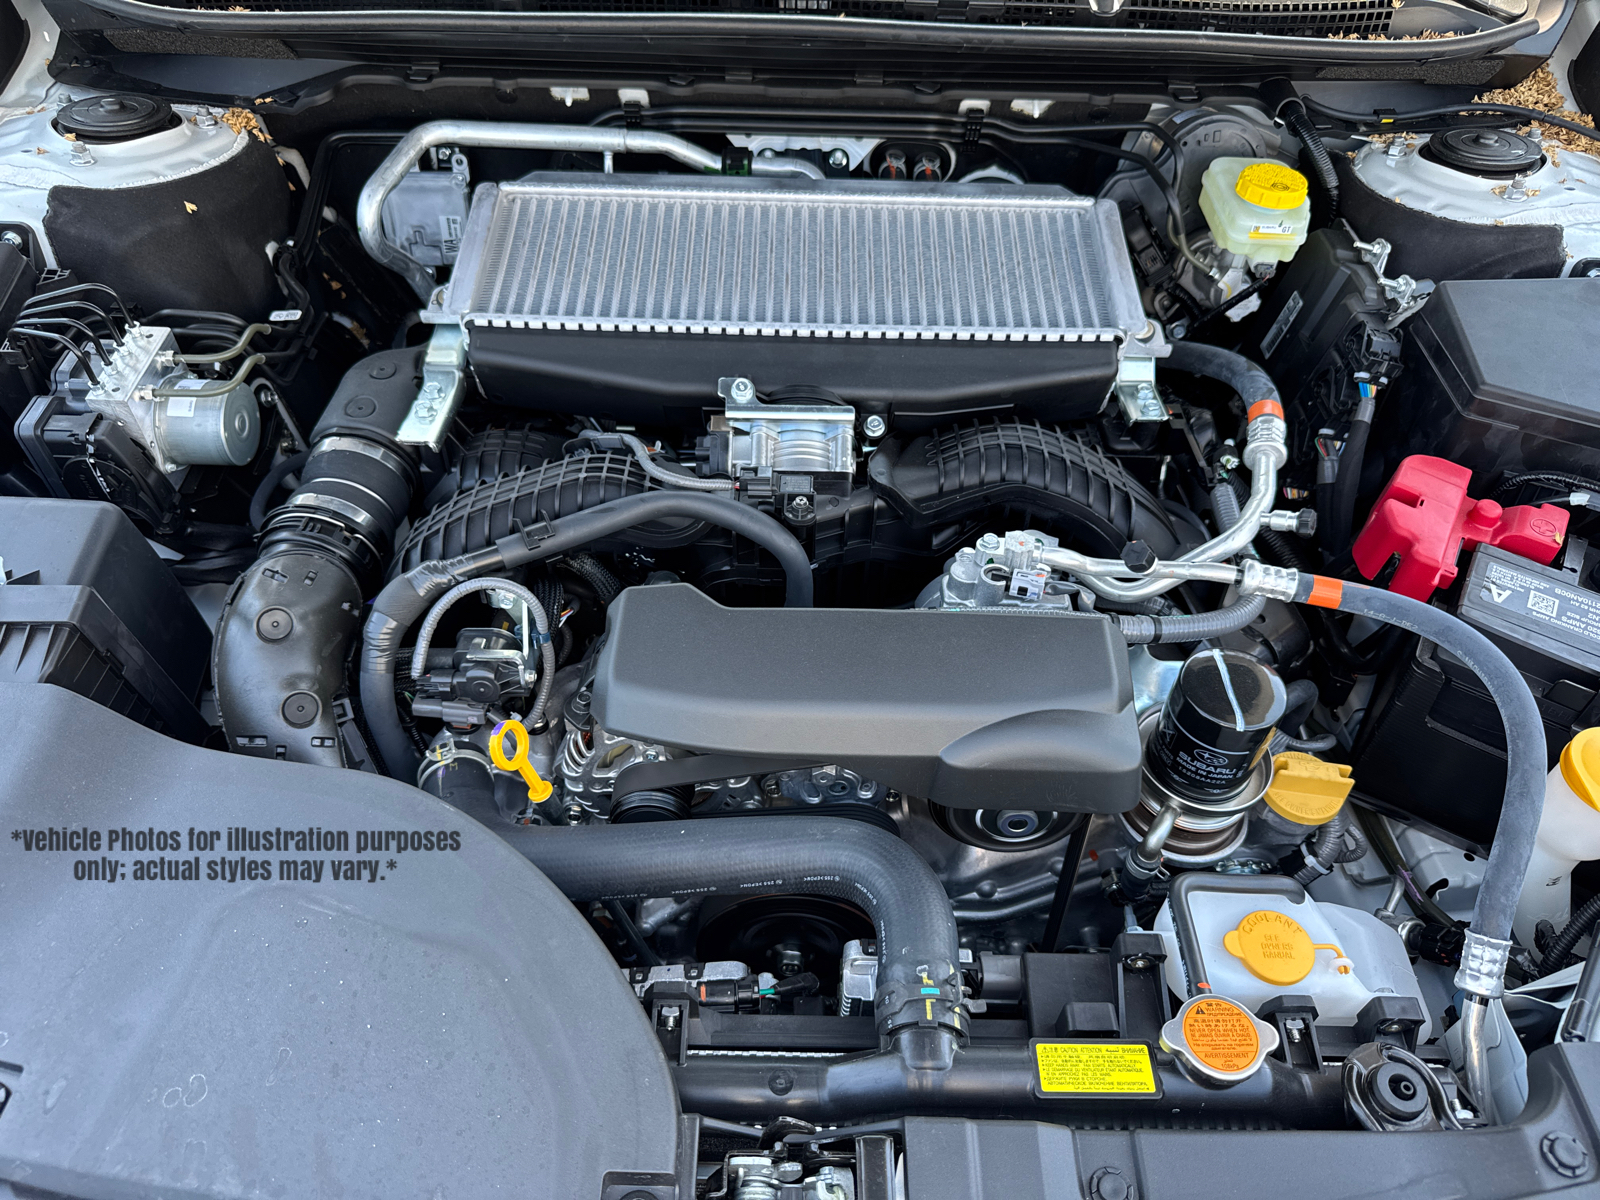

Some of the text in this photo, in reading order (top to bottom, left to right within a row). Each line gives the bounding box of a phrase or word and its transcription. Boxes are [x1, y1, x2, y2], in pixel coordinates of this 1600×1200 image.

[1532, 611, 1550, 621] AMPS
[1562, 616, 1586, 628] AMPS
[1550, 618, 1583, 634] CRANKING
[1176, 757, 1197, 771] MADE
[1179, 751, 1237, 774] SUBARU
[1242, 912, 1303, 934] COOLANT
[1263, 951, 1295, 959] MANUAL
